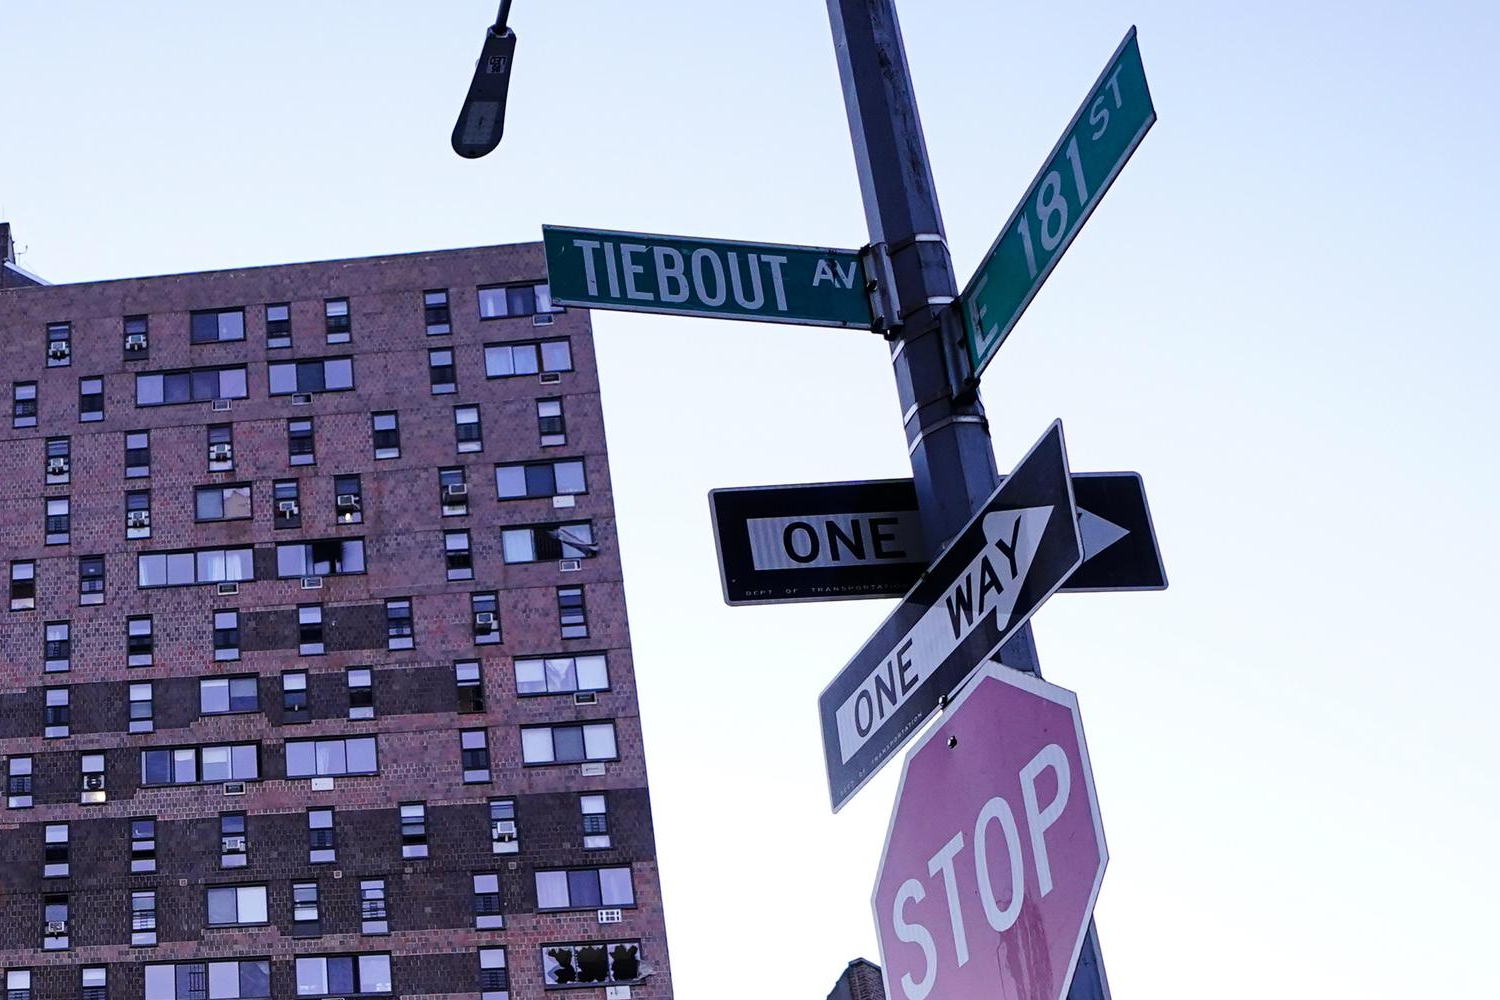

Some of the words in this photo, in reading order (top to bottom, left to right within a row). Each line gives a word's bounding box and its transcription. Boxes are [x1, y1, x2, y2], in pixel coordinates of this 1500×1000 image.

[572, 238, 789, 311] TIEBOUT
[812, 258, 857, 291] AV
[971, 273, 999, 361] E
[1016, 134, 1094, 280] 181
[1090, 63, 1124, 142] ST
[782, 517, 907, 564] ONE
[853, 637, 920, 738] ONE
[944, 514, 1023, 641] WAY
